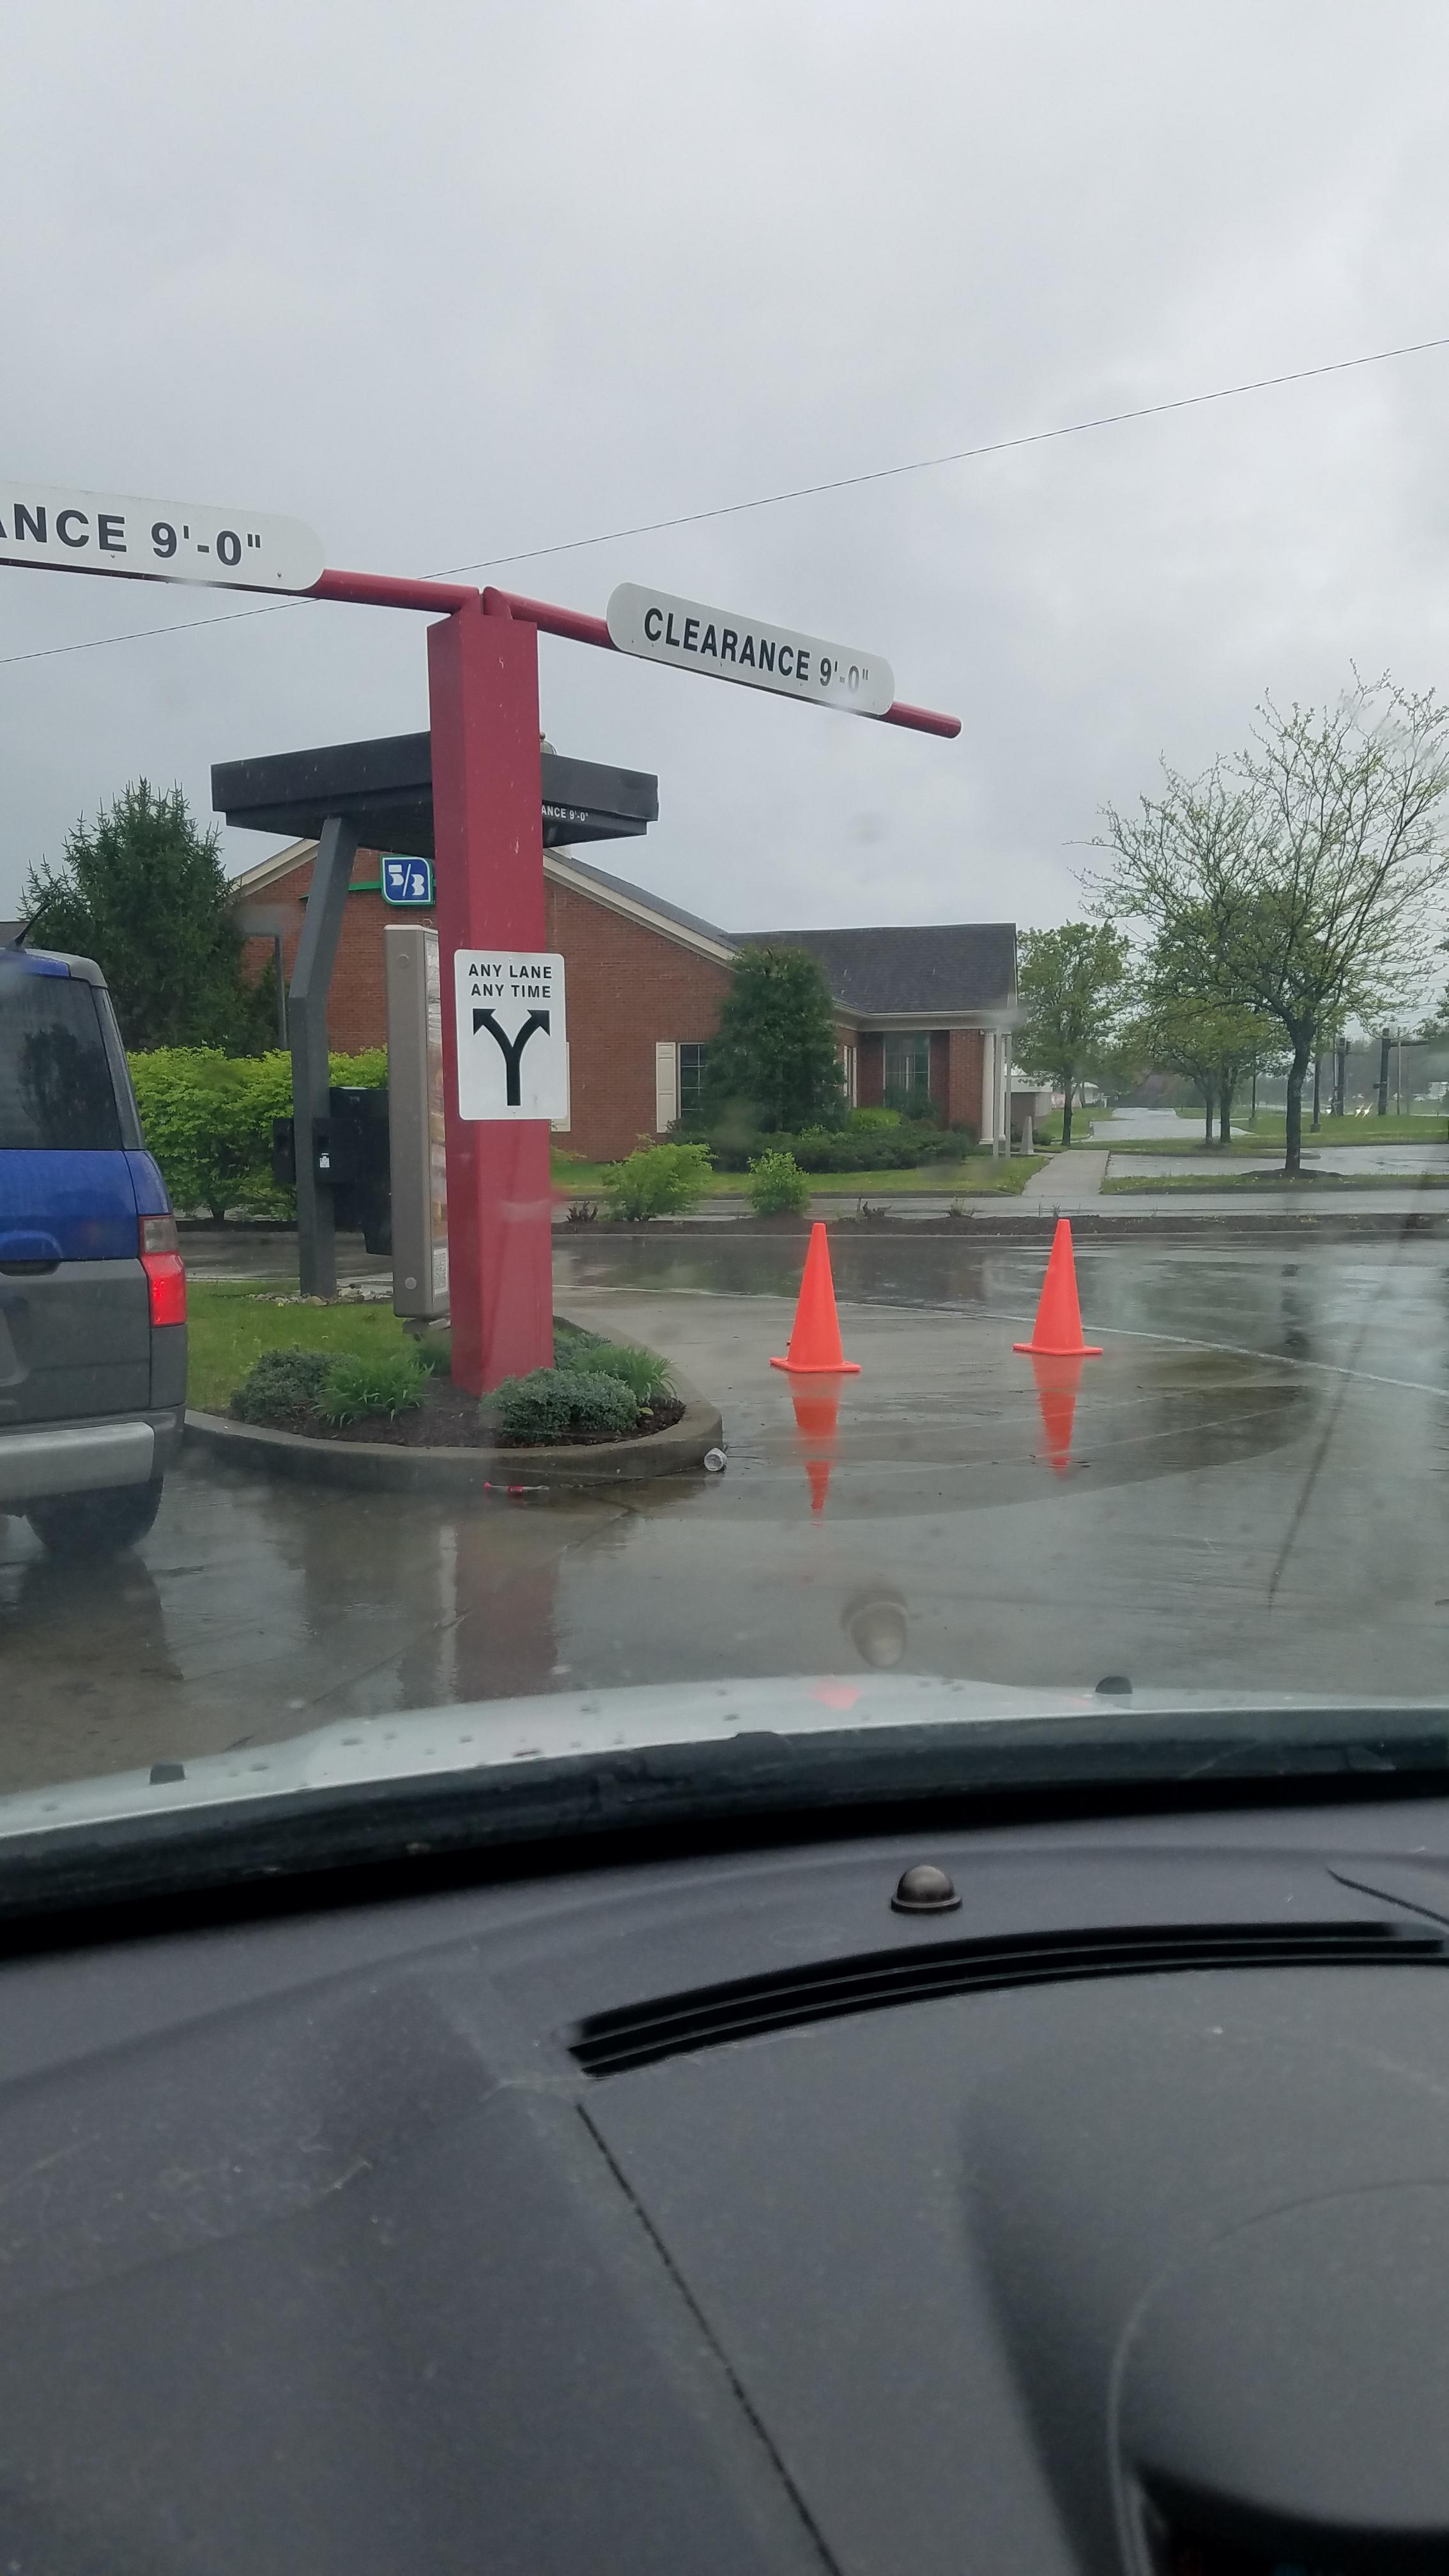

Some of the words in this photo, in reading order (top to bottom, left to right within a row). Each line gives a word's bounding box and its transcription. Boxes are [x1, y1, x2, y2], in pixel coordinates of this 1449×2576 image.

[0, 503, 127, 553] NCE
[151, 522, 261, 566] 9'-0"
[644, 608, 810, 681] CLEARANCE
[820, 657, 869, 694] 9'-0"
[468, 963, 502, 977] ANY
[509, 965, 552, 979] LANE
[471, 983, 504, 997] ANY
[511, 985, 551, 998] TIME
